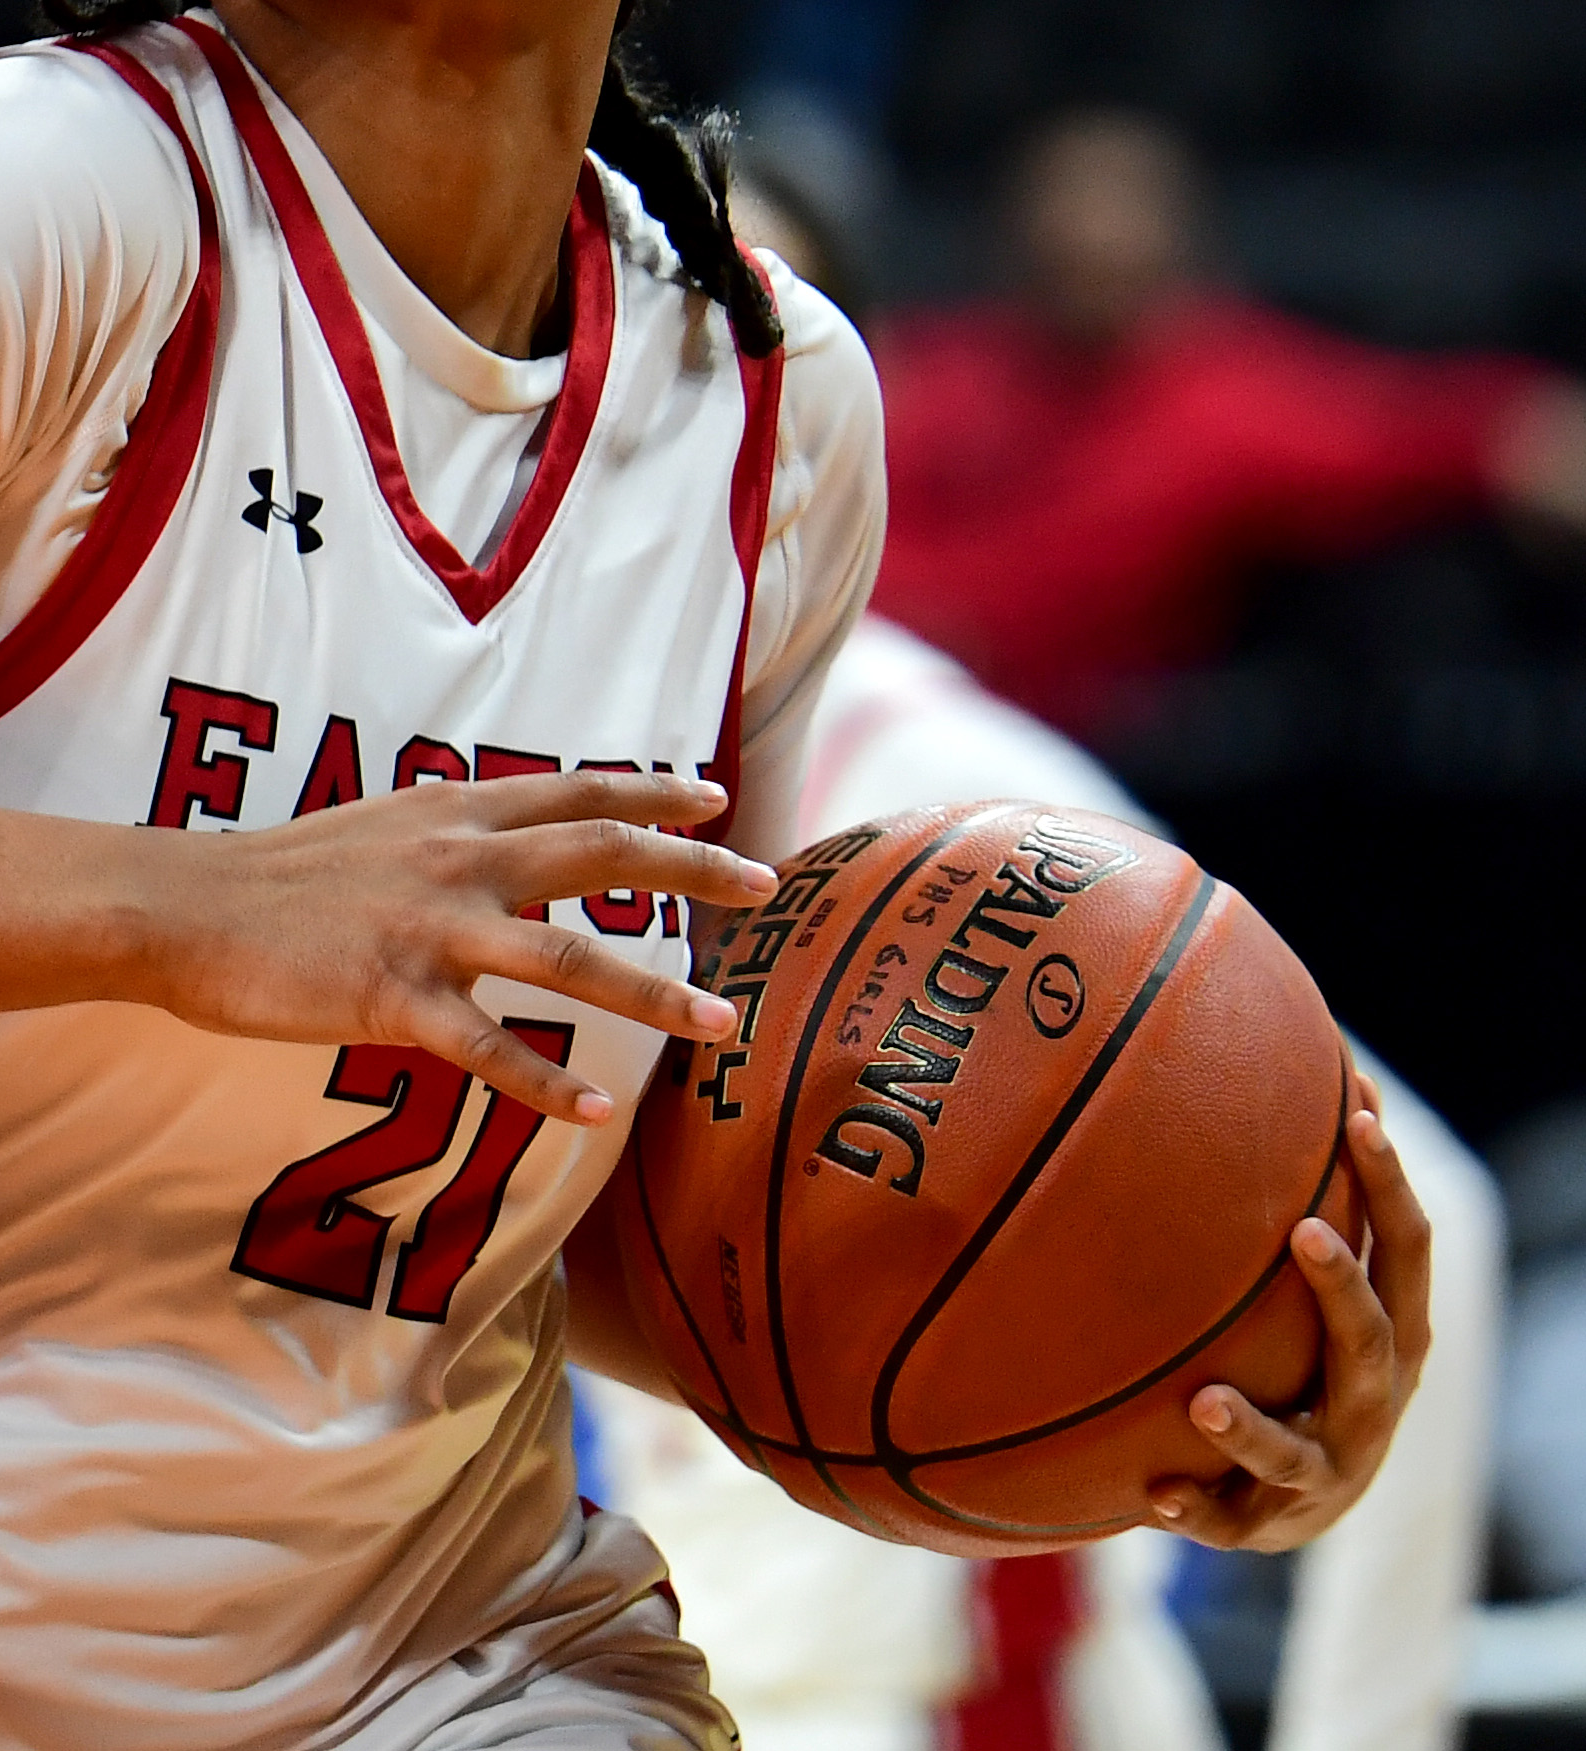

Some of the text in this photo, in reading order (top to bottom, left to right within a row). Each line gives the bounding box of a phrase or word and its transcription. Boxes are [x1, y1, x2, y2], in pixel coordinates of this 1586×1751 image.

[696, 826, 888, 1123] EGACY
[814, 813, 1140, 1198] SPALDING
[837, 863, 978, 1047] PHS GIRLS
[229, 1015, 576, 1325] 21
